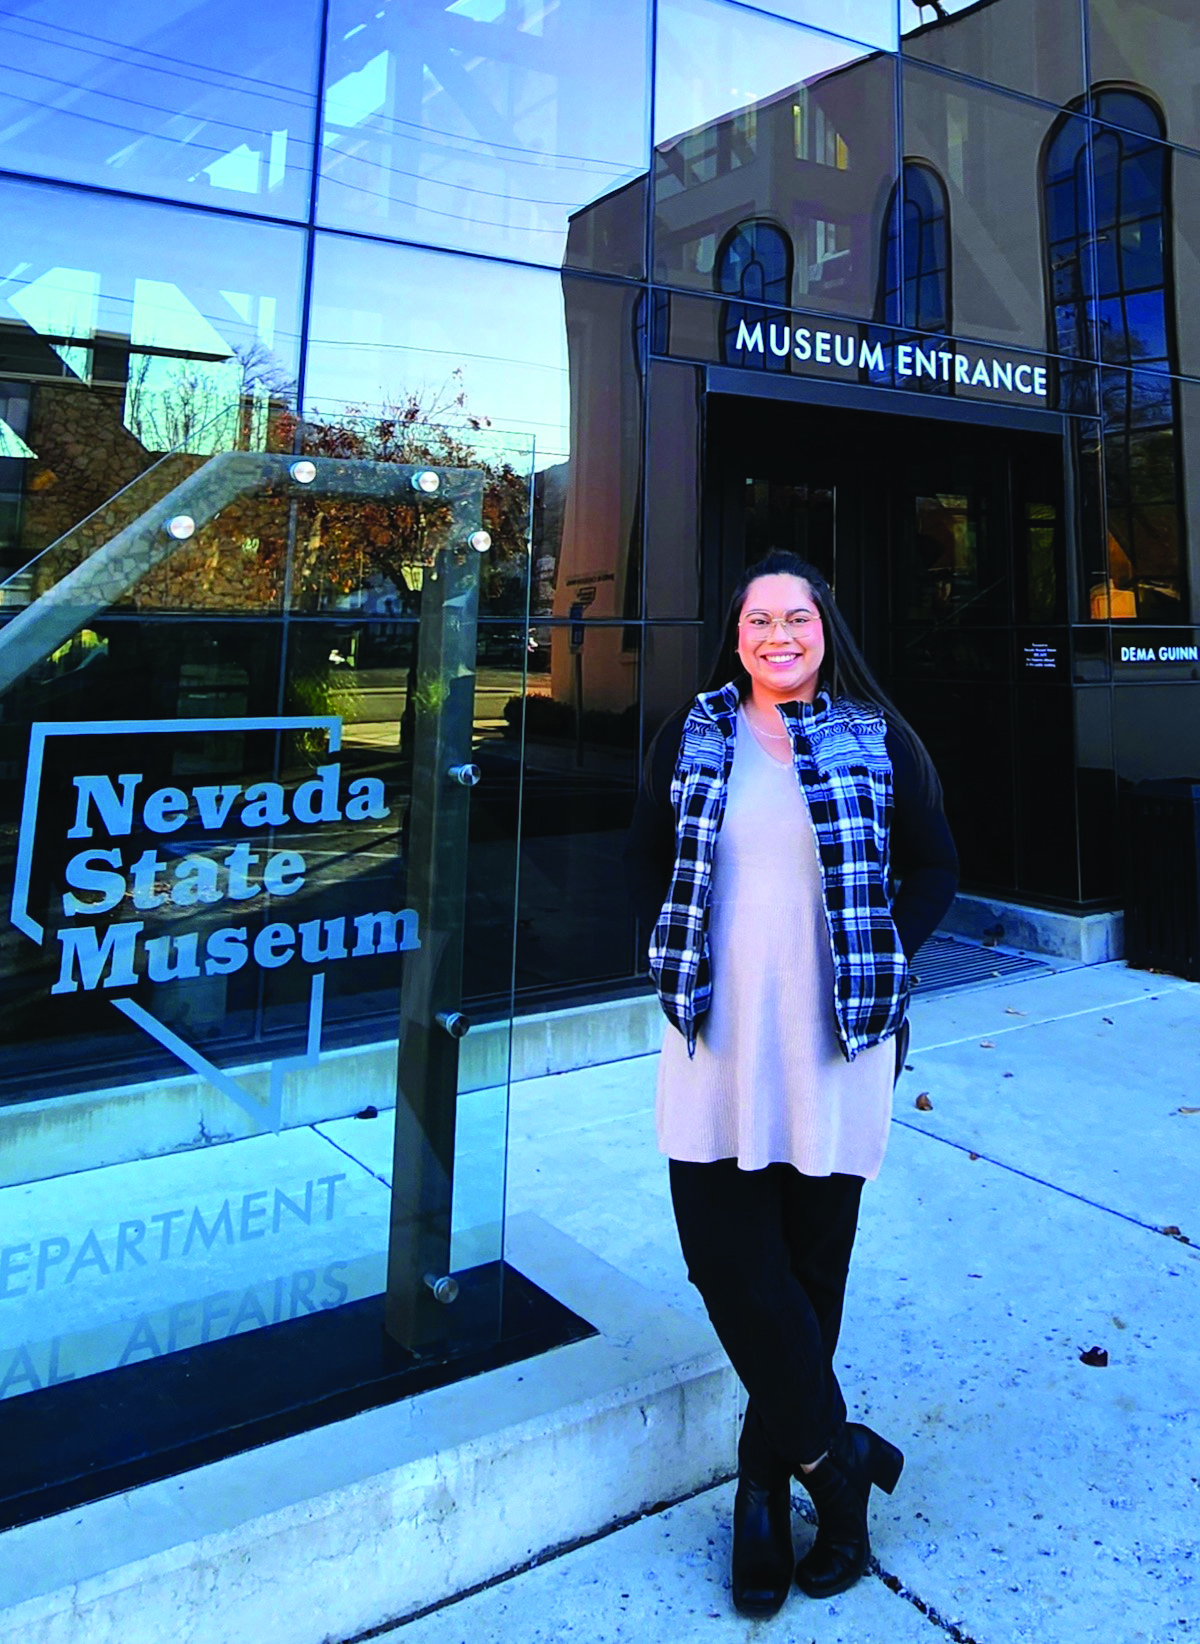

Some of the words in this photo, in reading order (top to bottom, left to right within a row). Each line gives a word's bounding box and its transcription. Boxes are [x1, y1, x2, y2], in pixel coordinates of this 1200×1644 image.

[735, 319, 885, 372] MUSEUM
[897, 345, 1047, 396] ENTRANCE
[1121, 646, 1156, 661] DEMA
[1158, 646, 1199, 661] GUINN
[66, 763, 391, 838] Nevada
[62, 843, 307, 917] State
[51, 908, 422, 995] Museum
[116, 1260, 349, 1368] AFFAIRS
